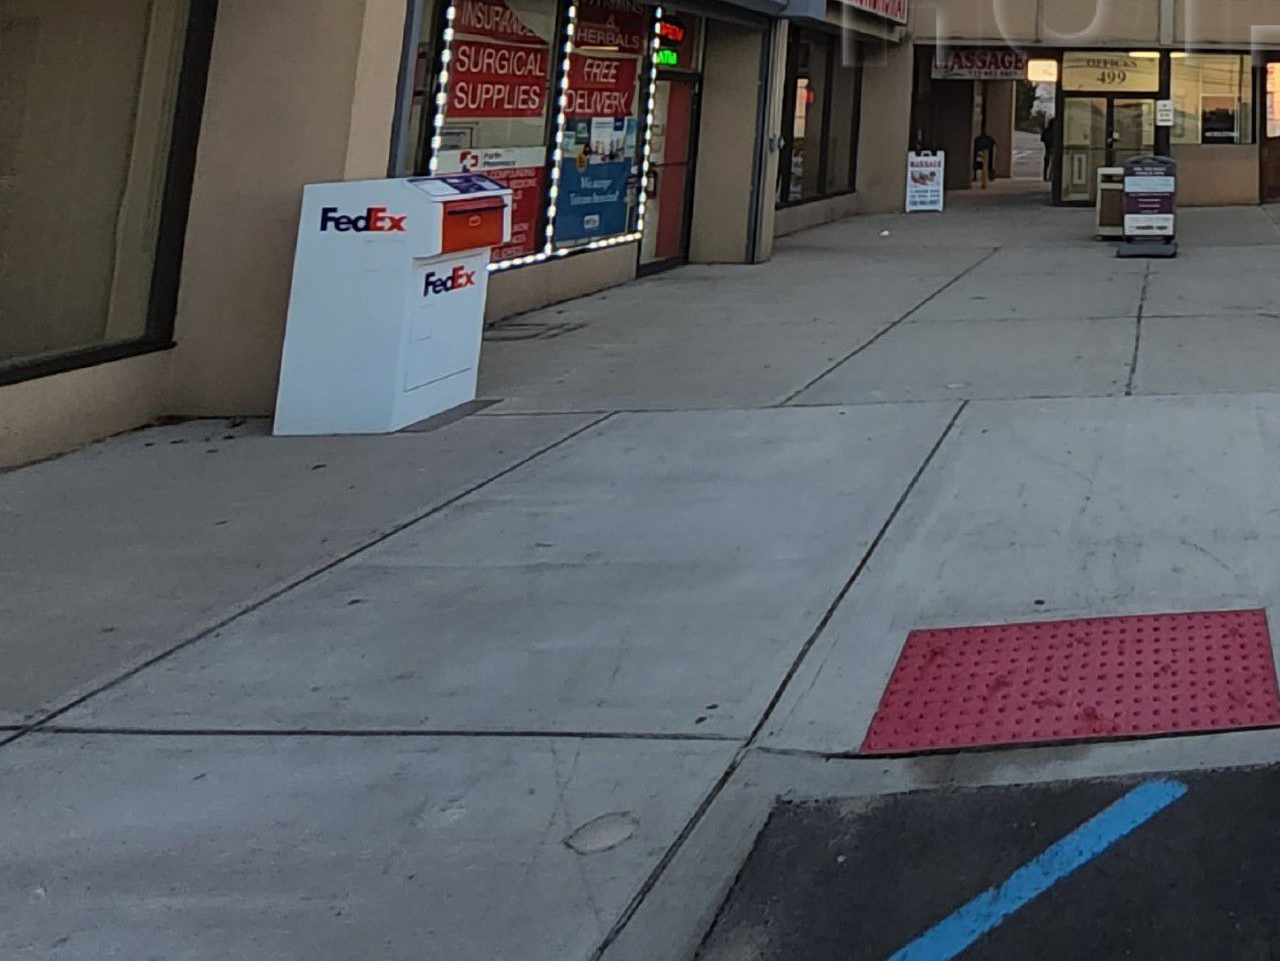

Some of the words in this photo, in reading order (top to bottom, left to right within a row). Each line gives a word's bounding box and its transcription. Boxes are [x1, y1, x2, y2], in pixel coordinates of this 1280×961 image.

[577, 27, 640, 49] HERBALS
[456, 45, 545, 77] SURGICAL
[584, 59, 620, 83] FREE
[1096, 70, 1127, 84] 499
[454, 81, 540, 109] SUPPLIES
[564, 89, 629, 114] DELIVERY
[320, 207, 407, 232] FedEx
[423, 265, 476, 298] FedEx
